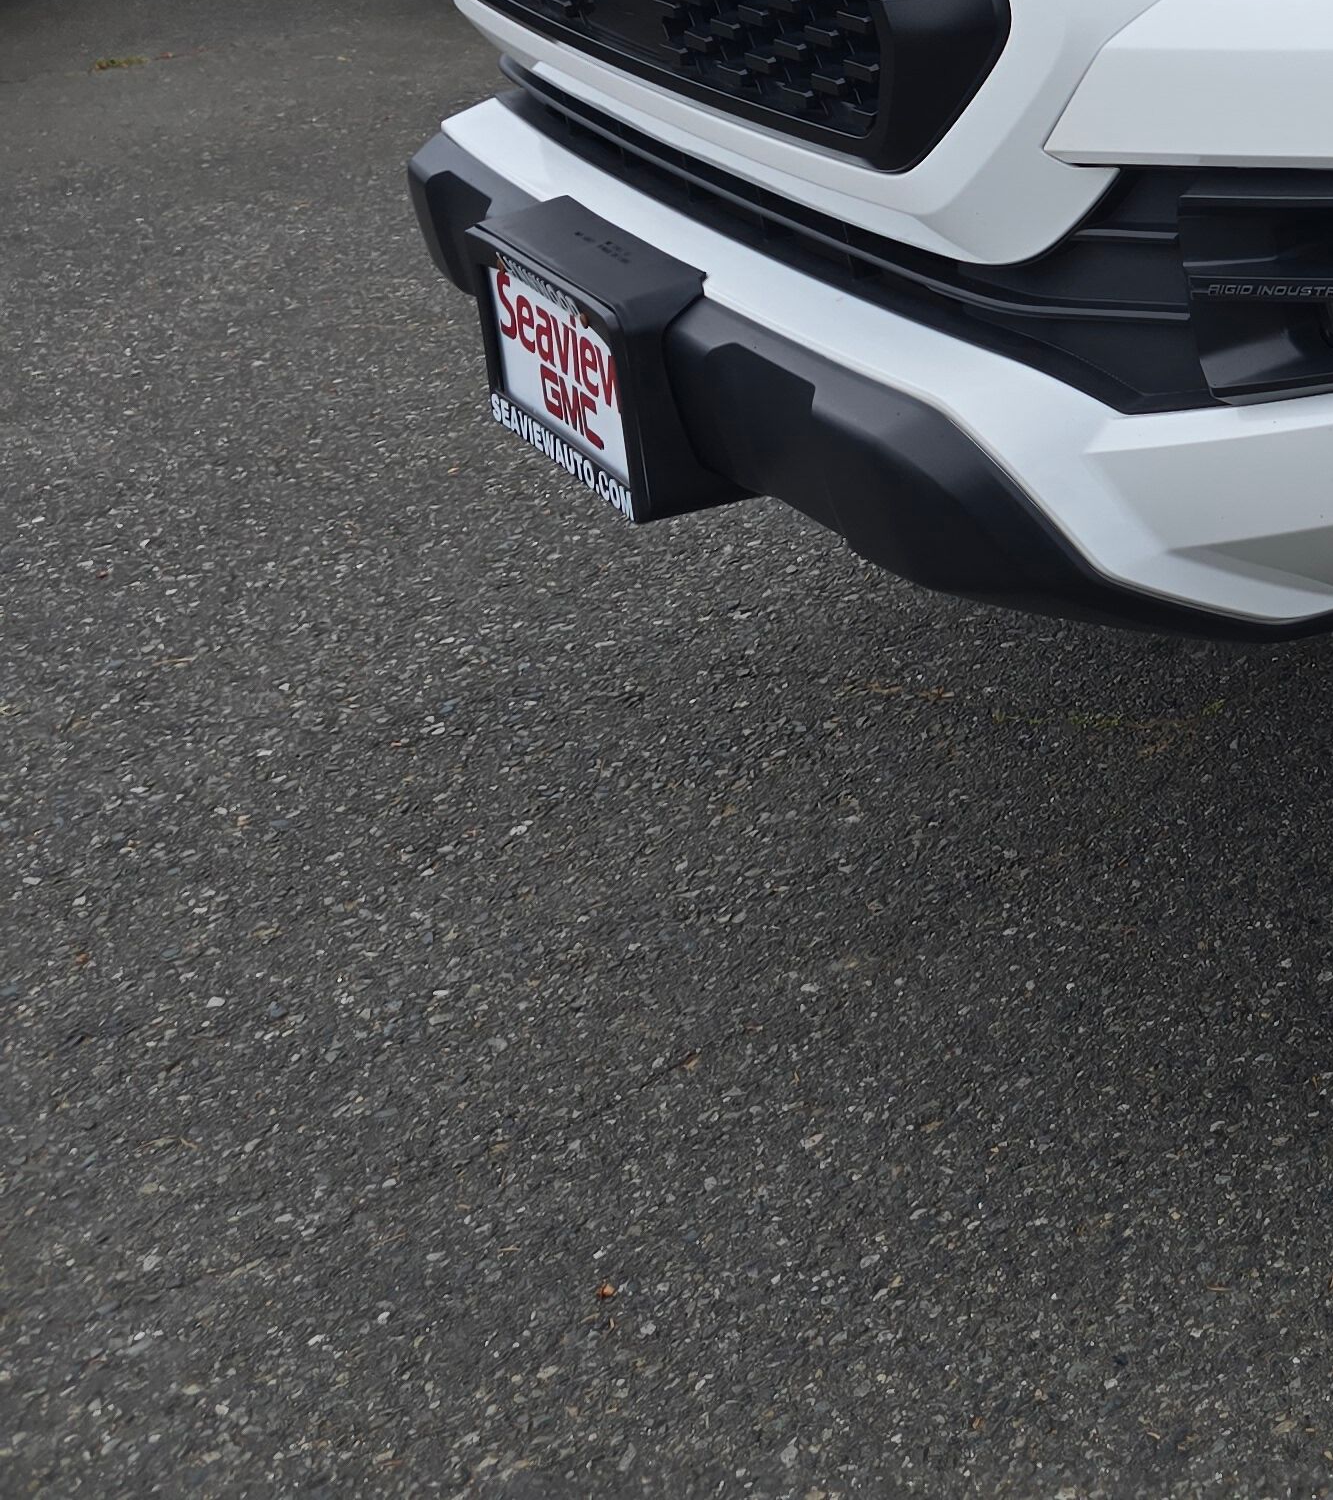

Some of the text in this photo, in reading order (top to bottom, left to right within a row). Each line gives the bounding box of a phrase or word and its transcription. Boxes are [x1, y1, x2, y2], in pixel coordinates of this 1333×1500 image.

[497, 270, 622, 414] Seaview
[1208, 284, 1253, 296] RIGID
[490, 393, 635, 521] SEAVIEWAUTO.COM
[540, 364, 605, 451] GMC
